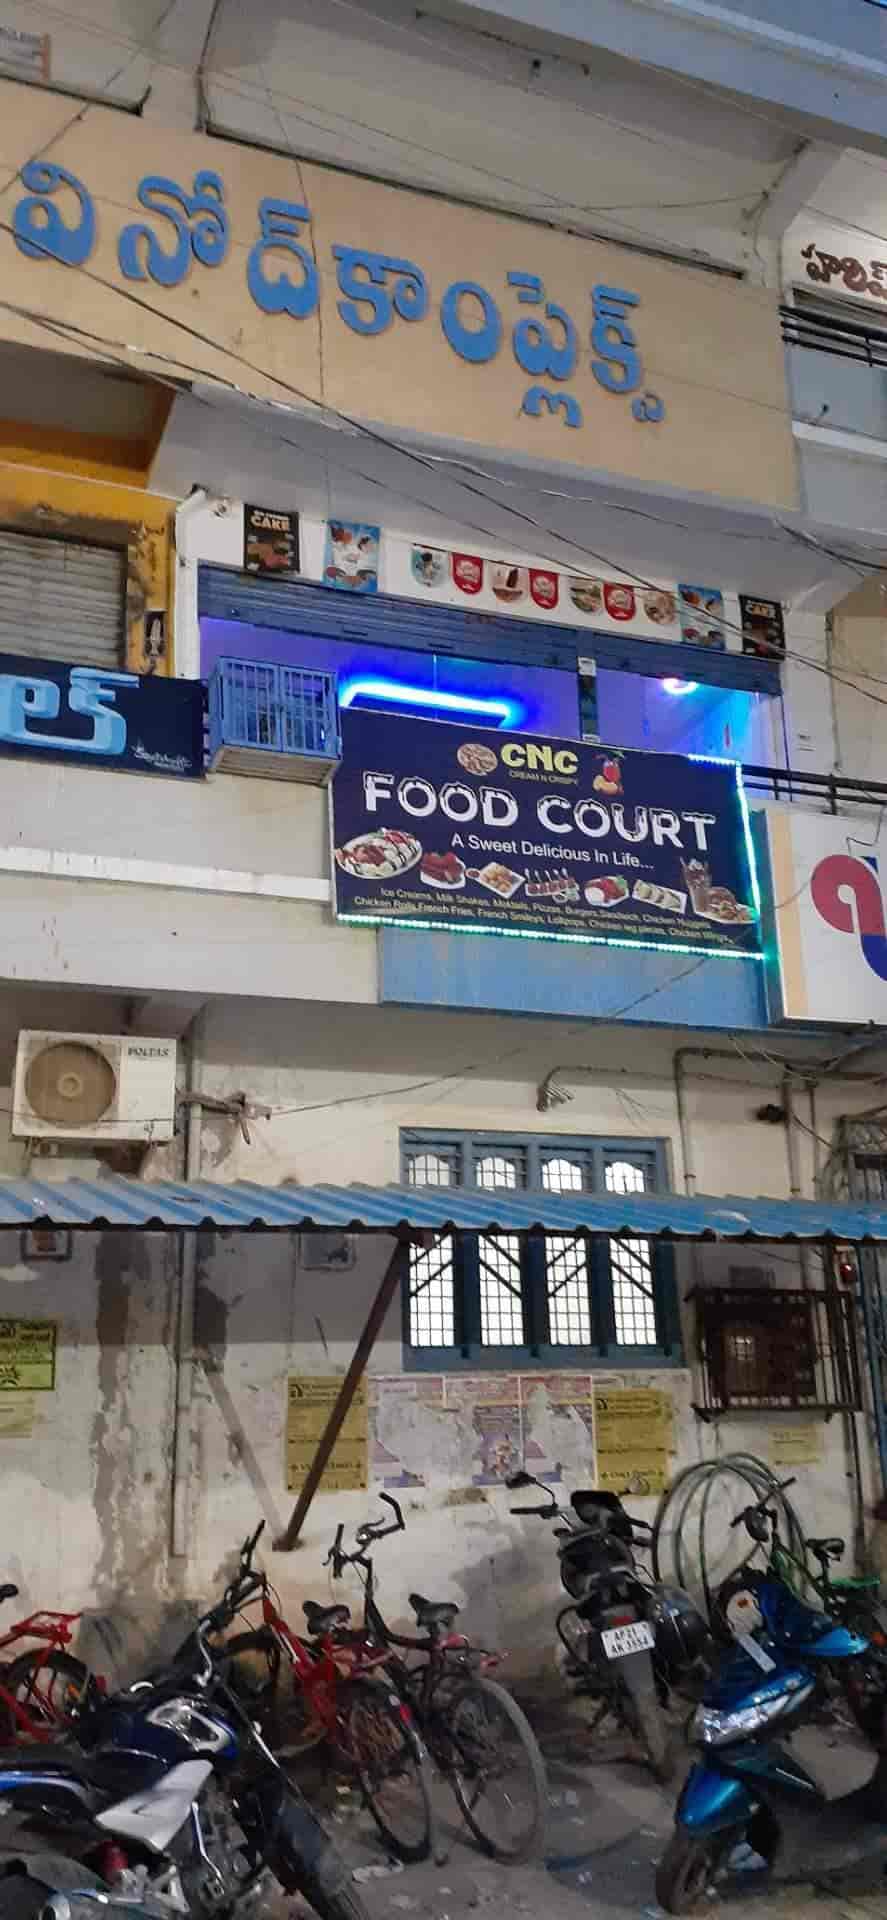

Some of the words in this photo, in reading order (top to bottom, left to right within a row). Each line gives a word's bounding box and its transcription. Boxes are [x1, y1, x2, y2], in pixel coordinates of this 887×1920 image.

[501, 743, 579, 774] CNC
[363, 771, 518, 826] FOOD
[537, 795, 716, 850] COURT
[451, 833, 464, 848] A
[468, 835, 517, 853] Sweet
[522, 841, 590, 862] Delicious
[594, 850, 609, 863] In
